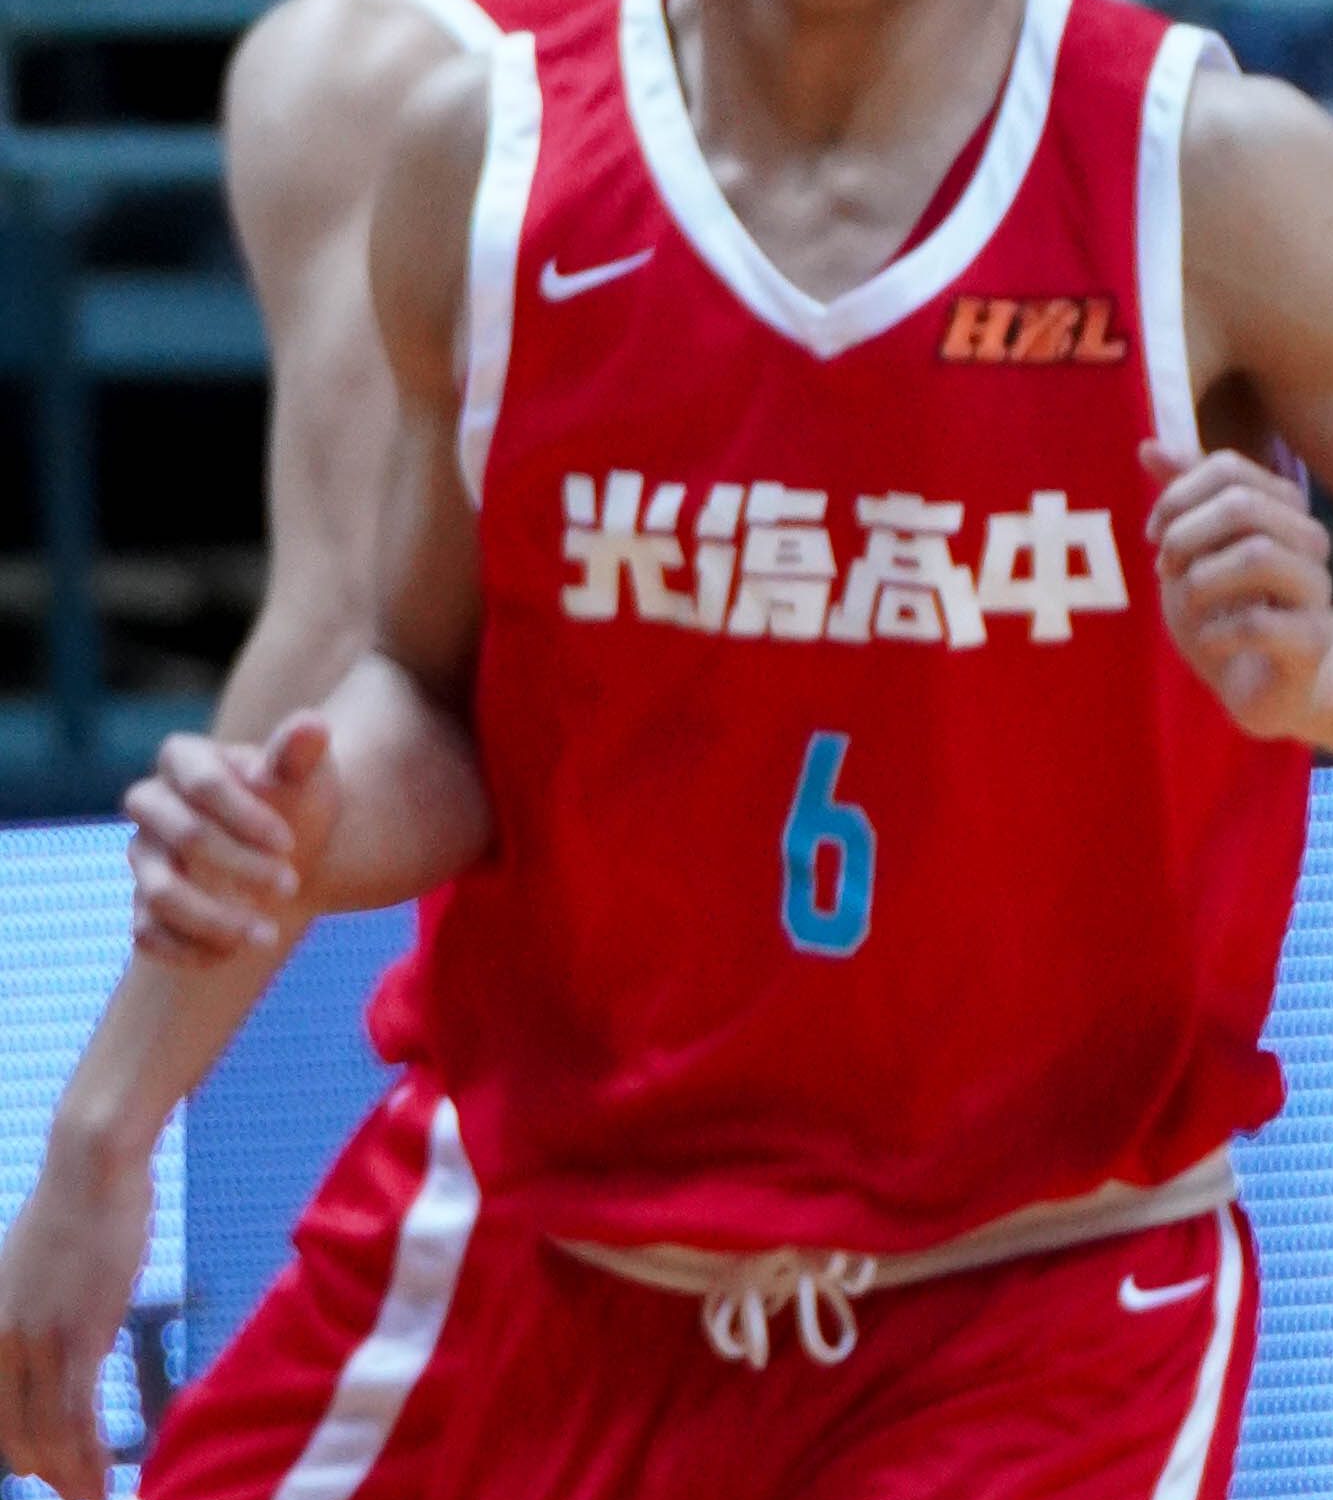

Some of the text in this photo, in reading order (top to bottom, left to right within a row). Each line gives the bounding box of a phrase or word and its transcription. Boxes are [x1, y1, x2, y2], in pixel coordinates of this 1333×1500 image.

[938, 295, 1129, 364] HBL
[560, 468, 1130, 651] 光復高中
[780, 730, 877, 958] 6
